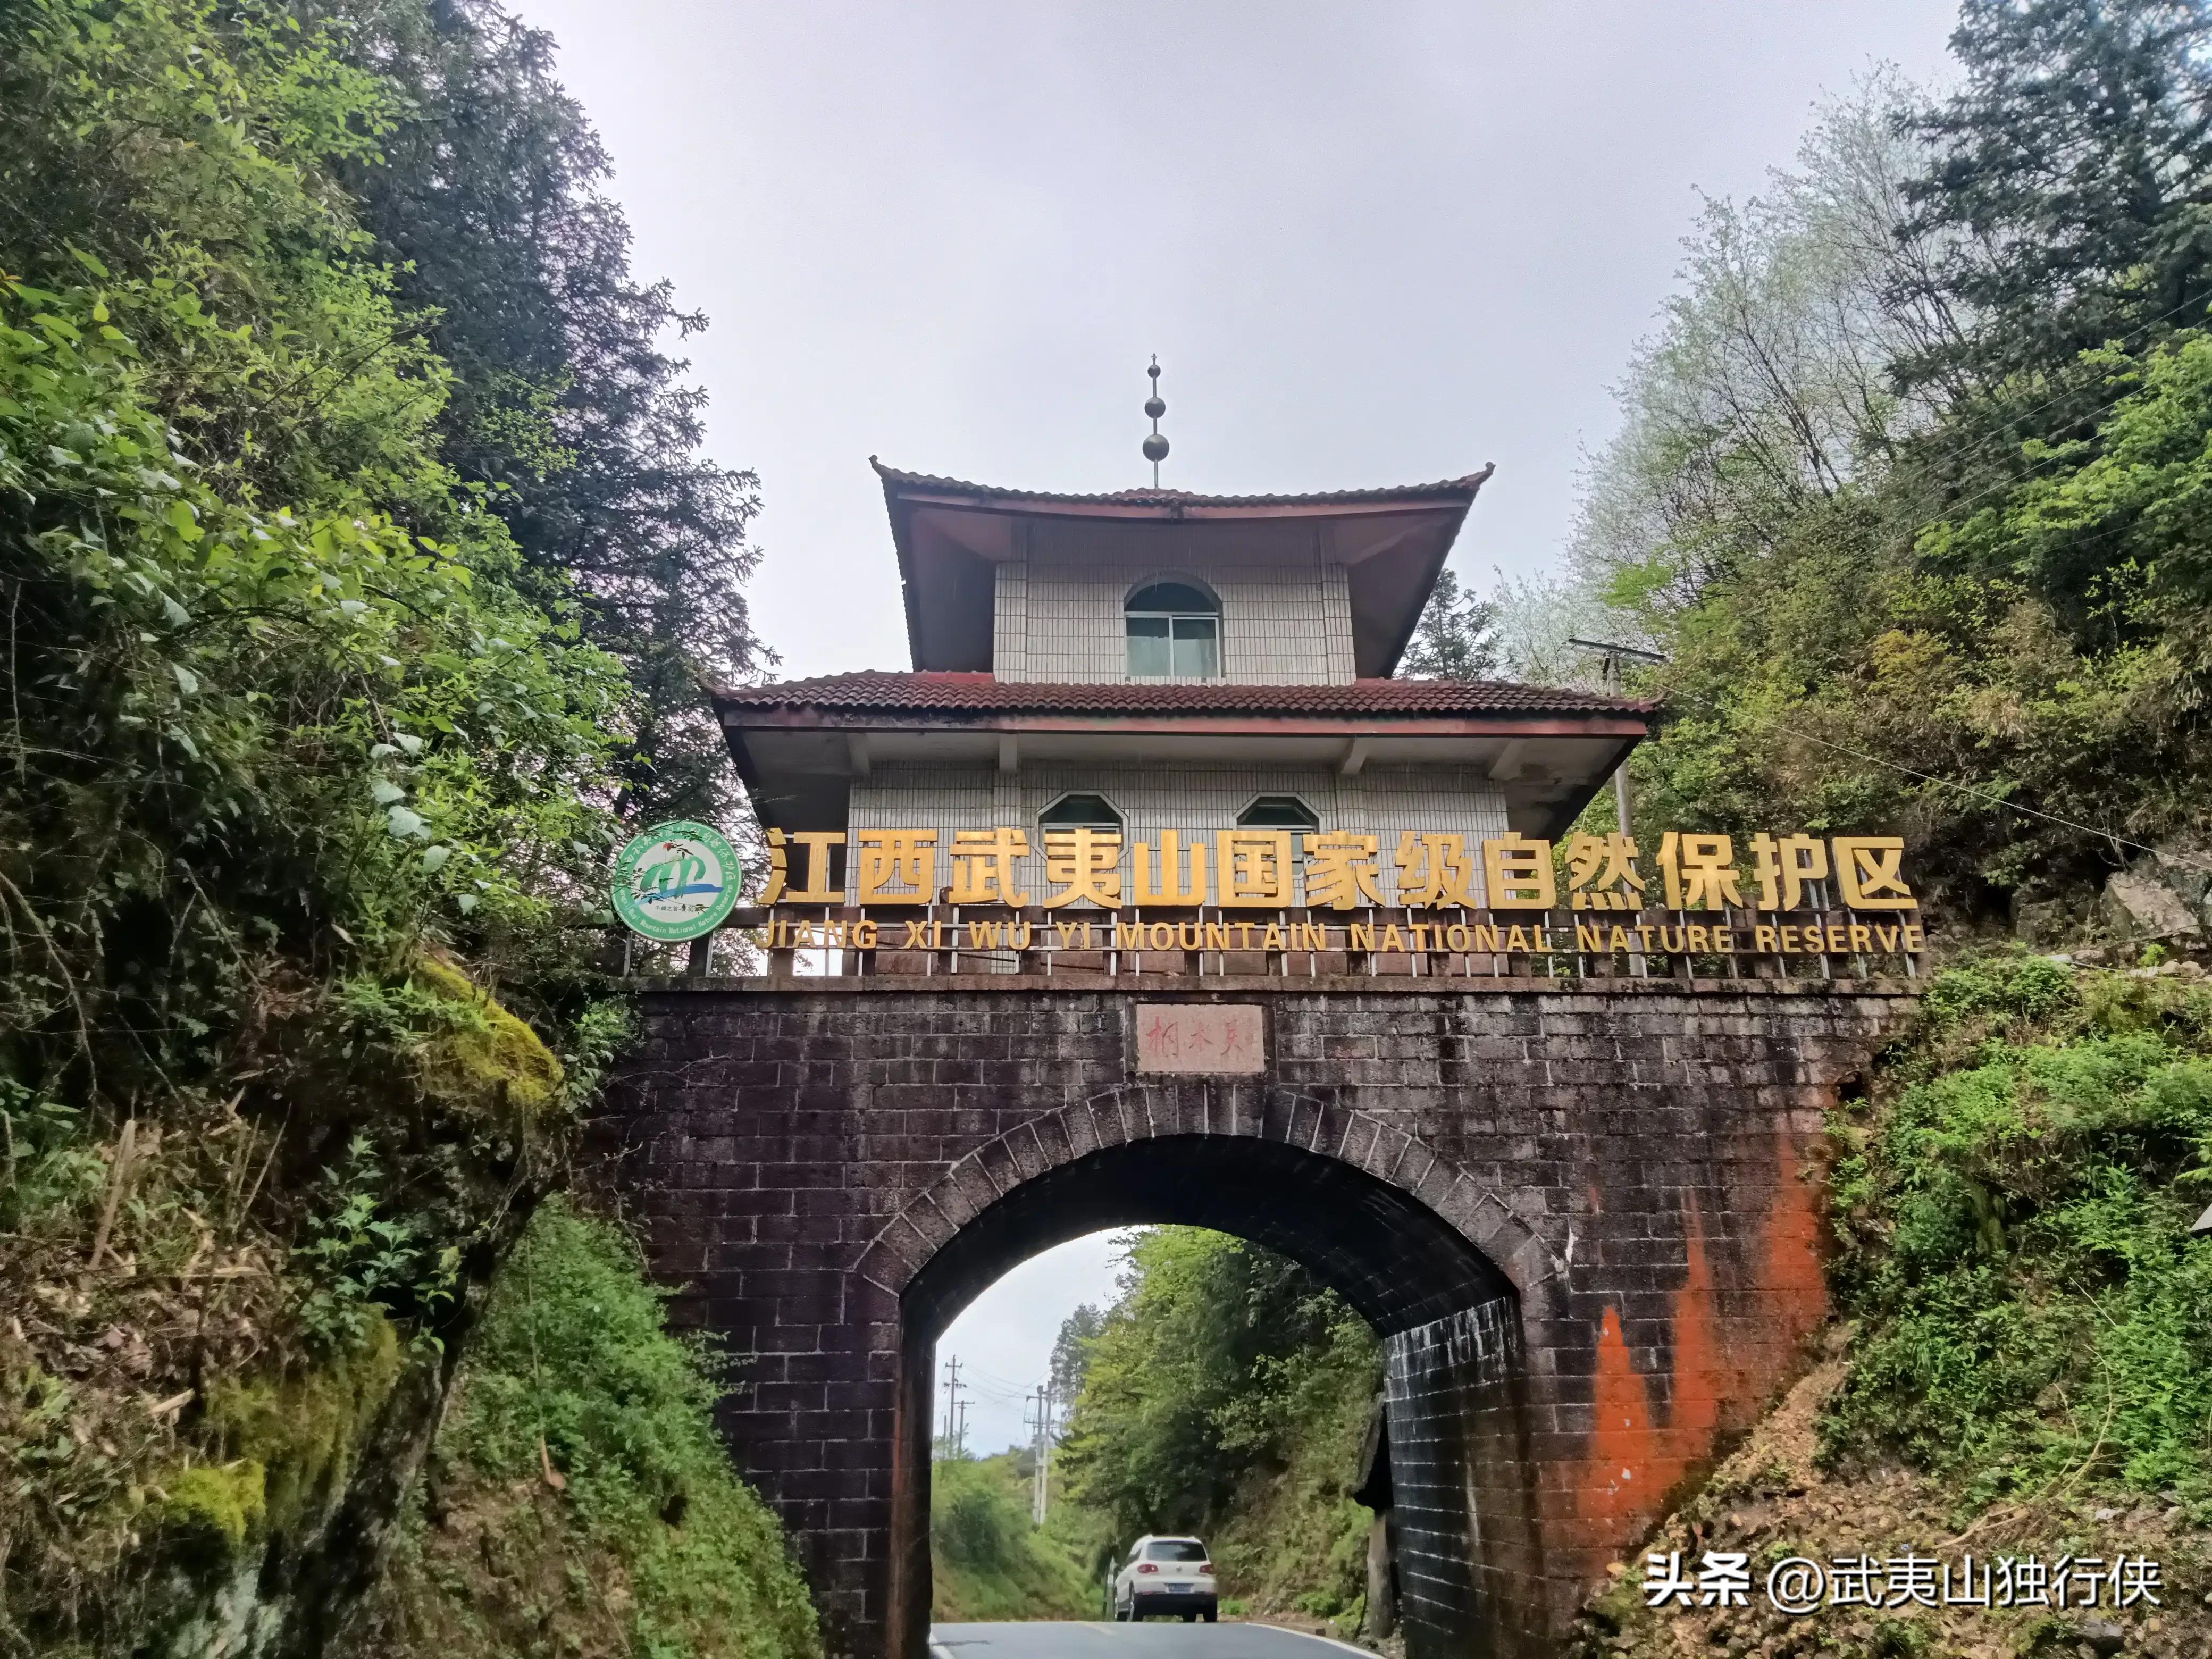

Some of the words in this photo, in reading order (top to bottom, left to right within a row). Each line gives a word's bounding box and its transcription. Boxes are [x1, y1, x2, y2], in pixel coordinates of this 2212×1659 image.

[762, 827, 1918, 911] 江西武夷山国家级自然保护区
[640, 919, 667, 934] Mountain
[668, 924, 696, 934] National
[698, 912, 719, 928] Nature
[716, 884, 734, 912] Reserve
[757, 920, 878, 950] JIANG
[904, 920, 942, 950] XI
[969, 920, 1030, 951] WU
[1055, 921, 1091, 951] YI
[1115, 922, 1326, 952] MOUNTAIN
[1350, 923, 1551, 953] NATIONAL
[1576, 925, 1732, 953] NATURE
[1755, 926, 1925, 954] RESERVE
